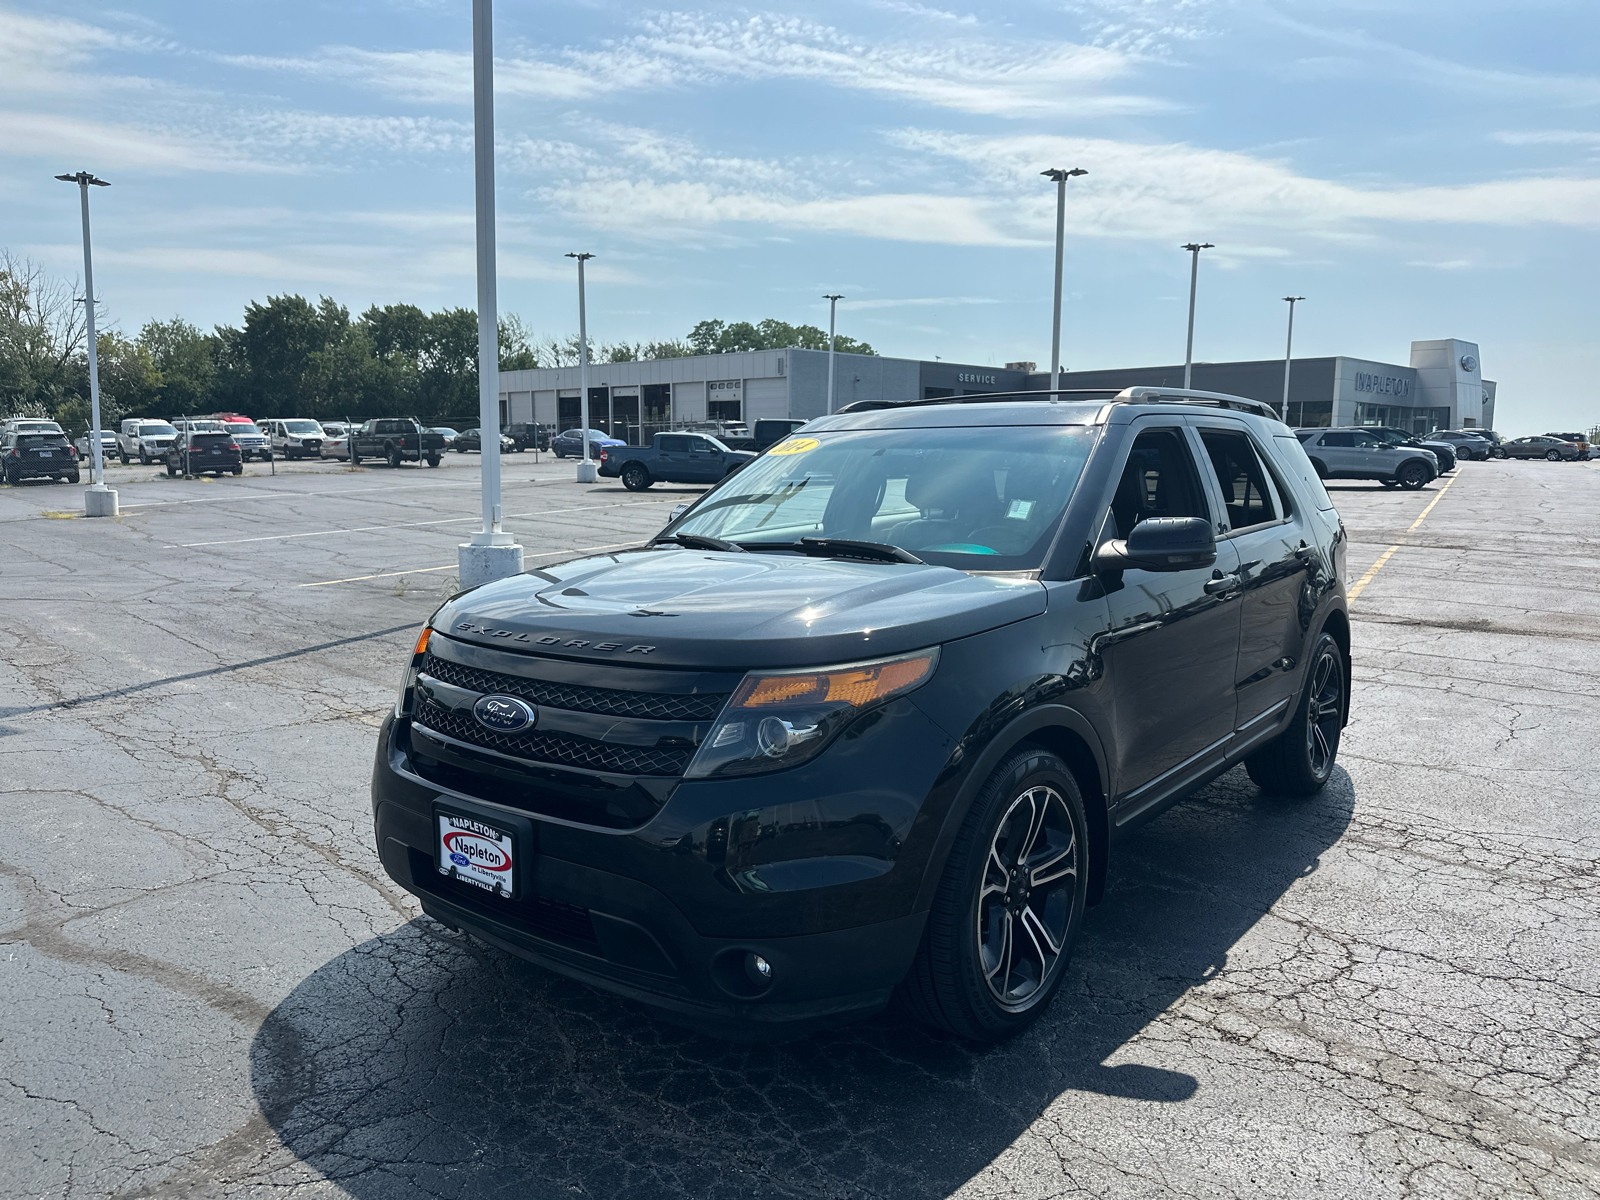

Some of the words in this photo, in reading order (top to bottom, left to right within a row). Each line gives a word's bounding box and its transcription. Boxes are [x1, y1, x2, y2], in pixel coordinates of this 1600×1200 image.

[958, 373, 995, 384] SERVICE
[1356, 372, 1410, 396] NAPLETON
[456, 622, 657, 655] EXPLORER
[483, 701, 516, 725] Ford
[453, 817, 497, 840] NAPLETON
[455, 836, 501, 866] Napleton
[456, 873, 493, 892] LIBERTYVILLE
[477, 867, 506, 883] Libertyville
